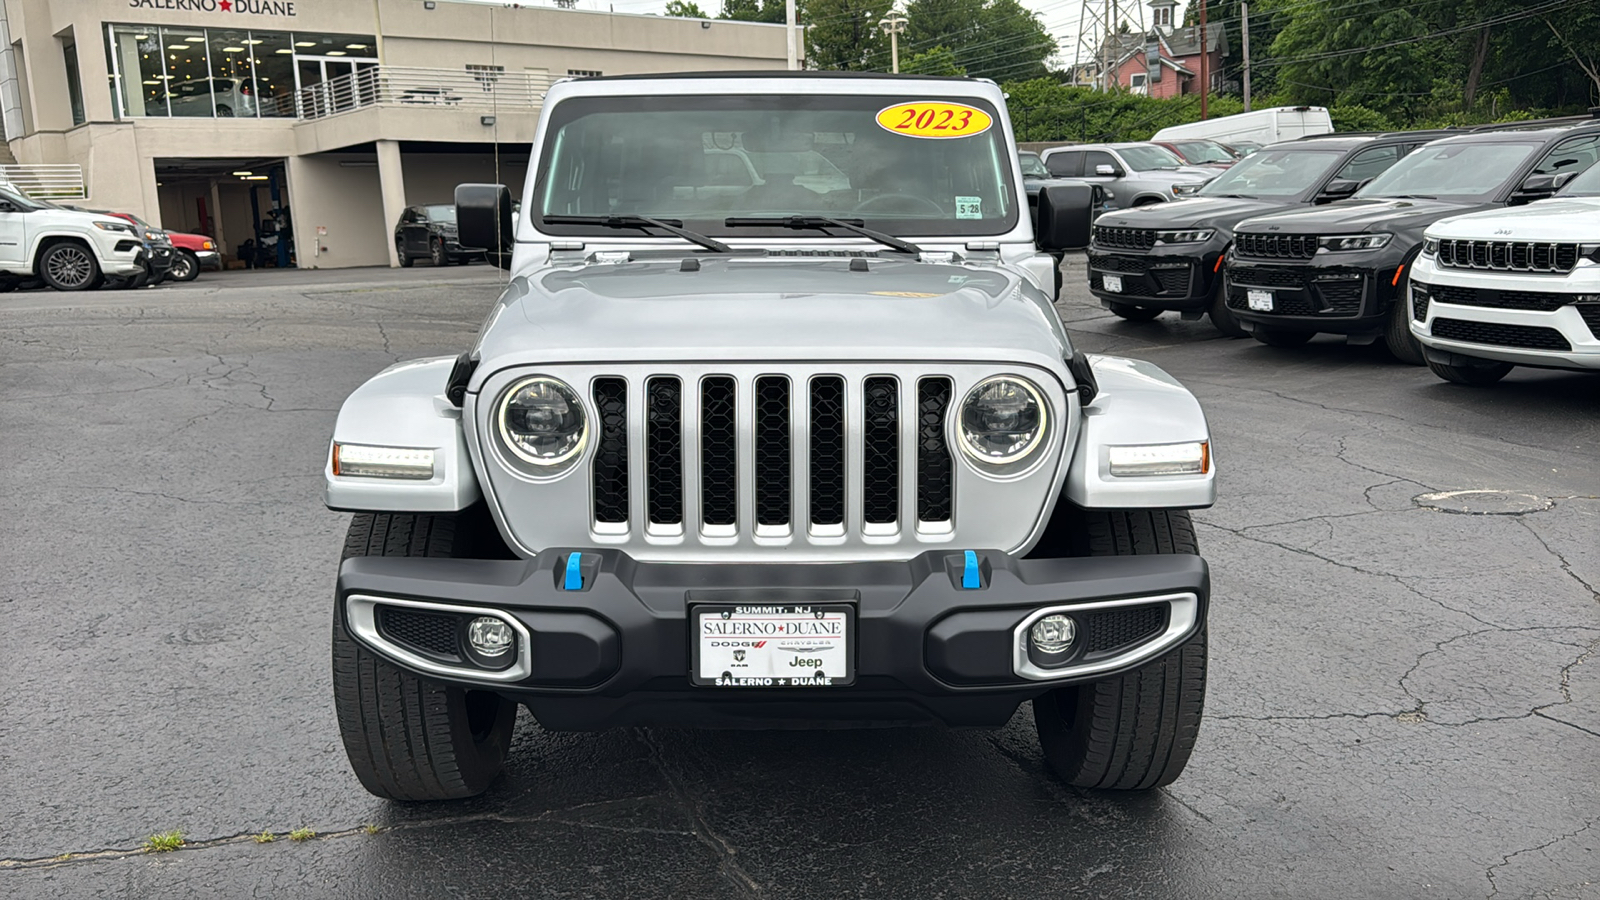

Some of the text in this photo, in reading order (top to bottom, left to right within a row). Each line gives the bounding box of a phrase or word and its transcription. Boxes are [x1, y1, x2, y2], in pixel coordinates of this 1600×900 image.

[235, 0, 297, 16] DUANE
[894, 108, 973, 131] 2023
[960, 204, 980, 214] 5 28
[794, 606, 811, 614] NJ
[703, 621, 842, 635] SALERNO DUANE
[788, 655, 823, 669] Jeep
[715, 677, 832, 686] SALERNO DUANE
